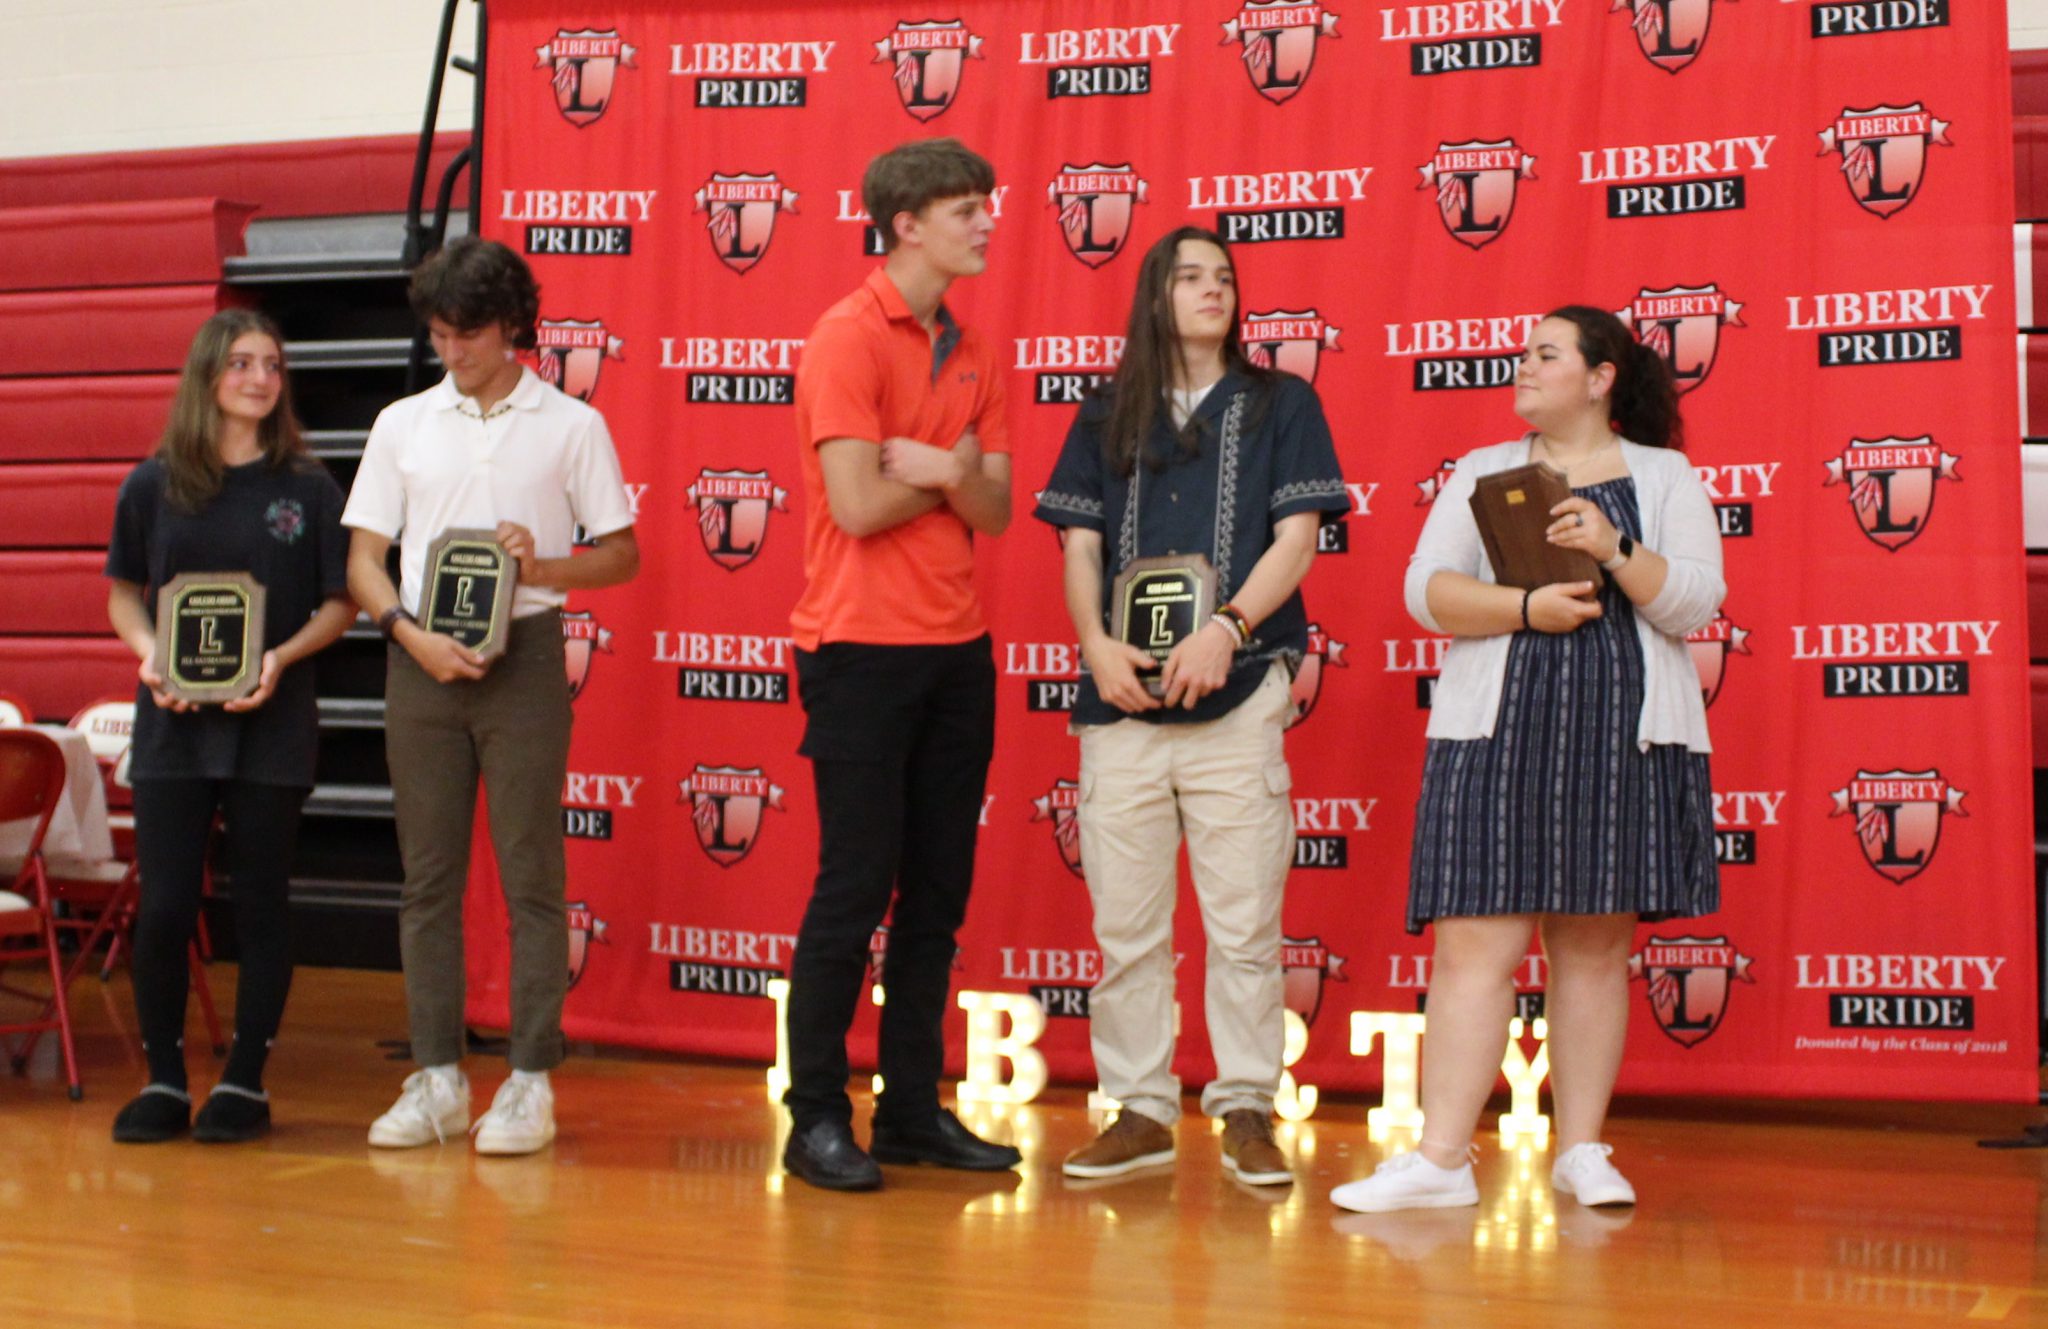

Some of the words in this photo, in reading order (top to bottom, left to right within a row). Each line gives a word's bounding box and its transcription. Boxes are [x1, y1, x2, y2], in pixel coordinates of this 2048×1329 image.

[1240, 6, 1319, 29] LIBERTY
[1380, 0, 1565, 40] LIBERTY
[1818, 0, 1940, 34] PRIDE
[553, 37, 620, 57] LIBERTY
[892, 29, 969, 49] LIBERTY
[1019, 24, 1181, 64] LIBERTY
[1420, 37, 1533, 73] PRIDE
[669, 41, 836, 75] LIBERTY
[1262, 29, 1301, 90] L
[567, 57, 602, 112] L
[699, 79, 800, 106] PRIDE
[908, 50, 948, 107] L
[1055, 66, 1148, 96] PRIDE
[1836, 113, 1929, 138] LIBERTY
[1435, 148, 1520, 173] LIBERTY
[1579, 135, 1777, 184] LIBERTY
[1861, 139, 1911, 201] L
[706, 182, 782, 201] LIBERTY
[1057, 173, 1136, 193] LIBERTY
[1187, 167, 1374, 210] LIBERTY
[1616, 179, 1736, 216] PRIDE
[501, 190, 656, 221] LIBERTY
[1453, 172, 1500, 233] L
[530, 227, 624, 252] PRIDE
[726, 202, 759, 258] L
[1080, 194, 1118, 253] L
[1226, 210, 1338, 241] PRIDE
[1633, 294, 1723, 318] LIBERTY
[1786, 284, 1993, 330] LIBERTY
[538, 329, 606, 346] LIBERTY
[1242, 320, 1323, 341] LIBERTY
[1384, 314, 1542, 356] LIBERT
[1827, 329, 1952, 363] PRIDE
[660, 337, 804, 369] LIBERT
[1013, 335, 1127, 370] LIBER
[691, 375, 787, 402] PRIDE
[1844, 447, 1939, 468] LIBERTY
[697, 477, 772, 498] LIBERTY
[1868, 471, 1918, 534] L
[718, 500, 756, 556] L
[453, 576, 475, 617] L
[199, 616, 222, 654] L
[1149, 604, 1174, 646] L
[1791, 621, 2000, 659] LIBERTY
[653, 631, 795, 668] LIBERT
[684, 670, 784, 700] PRIDE
[1834, 664, 1959, 695] PRIDE
[92, 717, 132, 736] LIBE
[691, 774, 766, 794] LIBERTY
[1851, 781, 1945, 801] LIBERTY
[712, 795, 747, 853] L
[1875, 803, 1924, 866] L
[1645, 946, 1733, 966] LIBERTY
[1795, 954, 2006, 990] LIBERTY
[1667, 968, 1712, 1029] L
[1840, 997, 1965, 1026] PRIDE
[1795, 1036, 1857, 1049] Donated
[1861, 1037, 1880, 1052] by
[1883, 1037, 1905, 1050] the
[1910, 1037, 1950, 1052] Class
[1953, 1039, 1970, 1055] of
